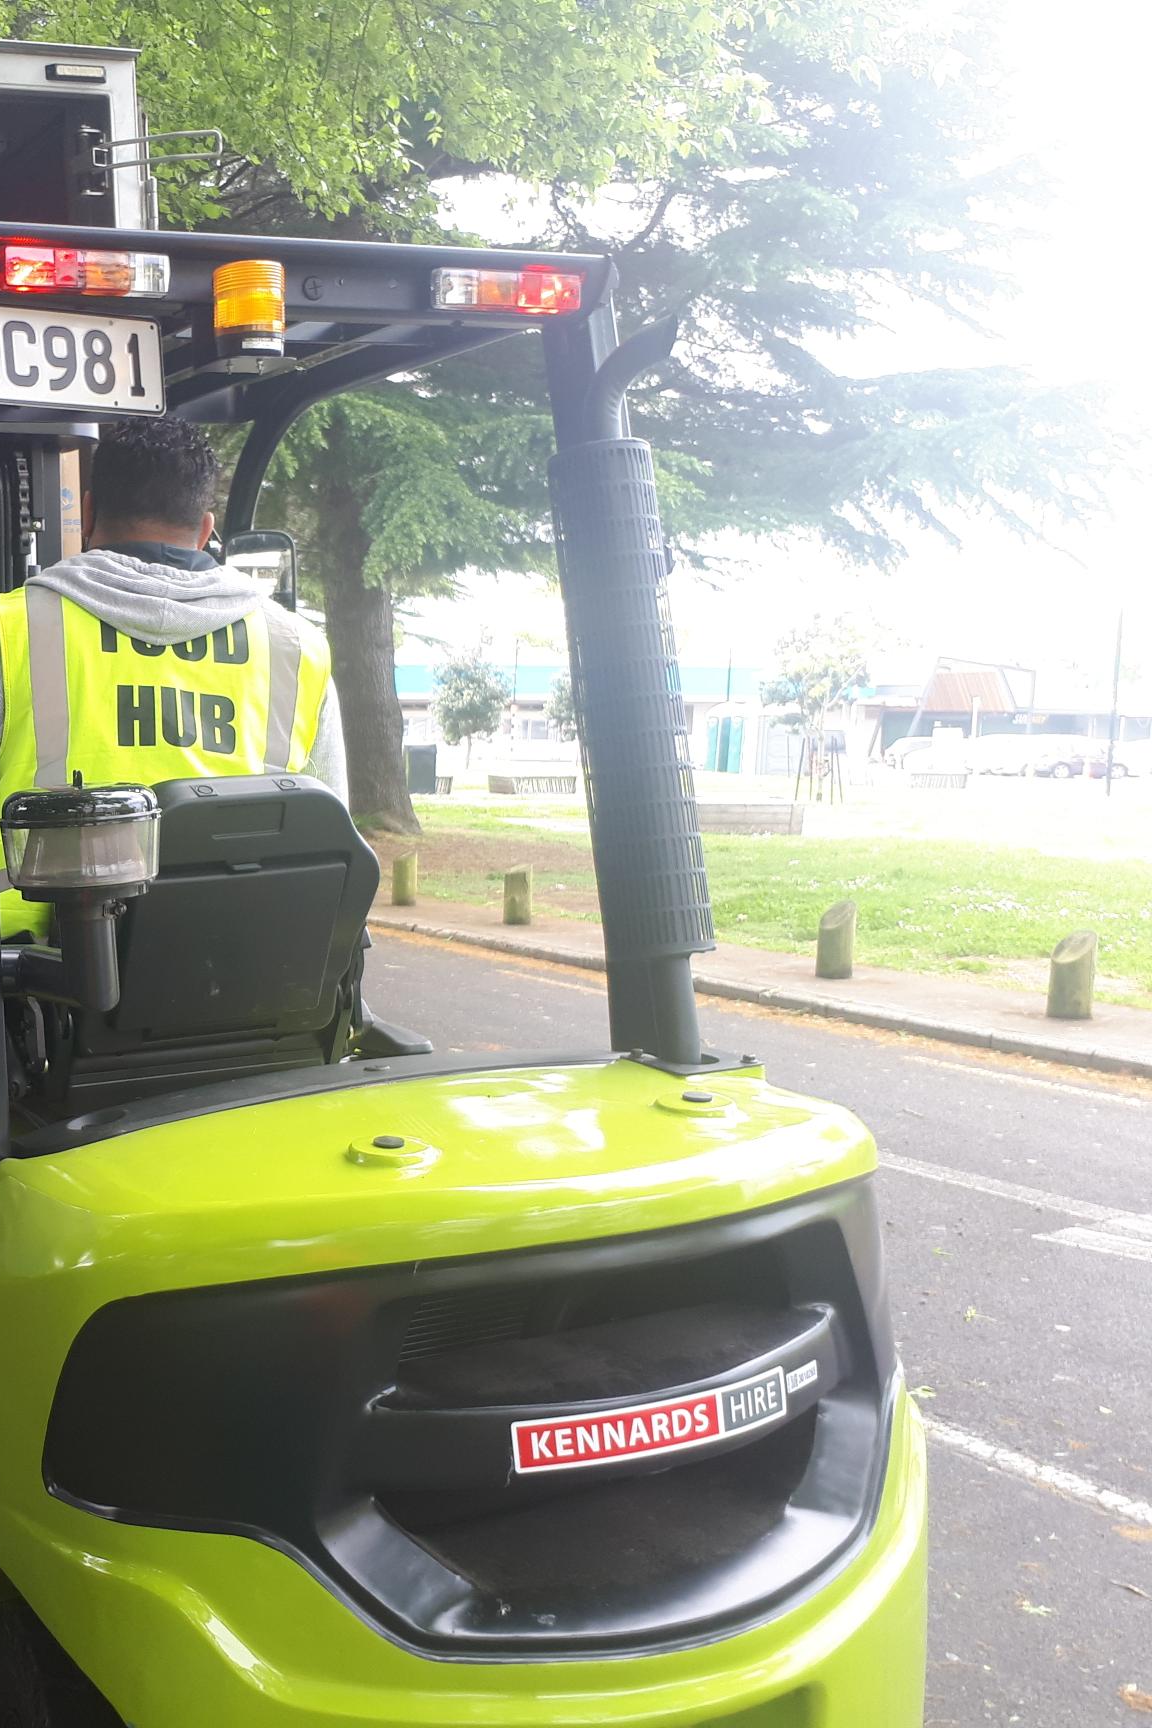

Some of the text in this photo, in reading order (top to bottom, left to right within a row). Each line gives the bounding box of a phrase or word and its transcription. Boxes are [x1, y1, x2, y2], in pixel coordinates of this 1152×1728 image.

[117, 684, 236, 754] HUB
[530, 1380, 778, 1460] KENNARDS HIRE
